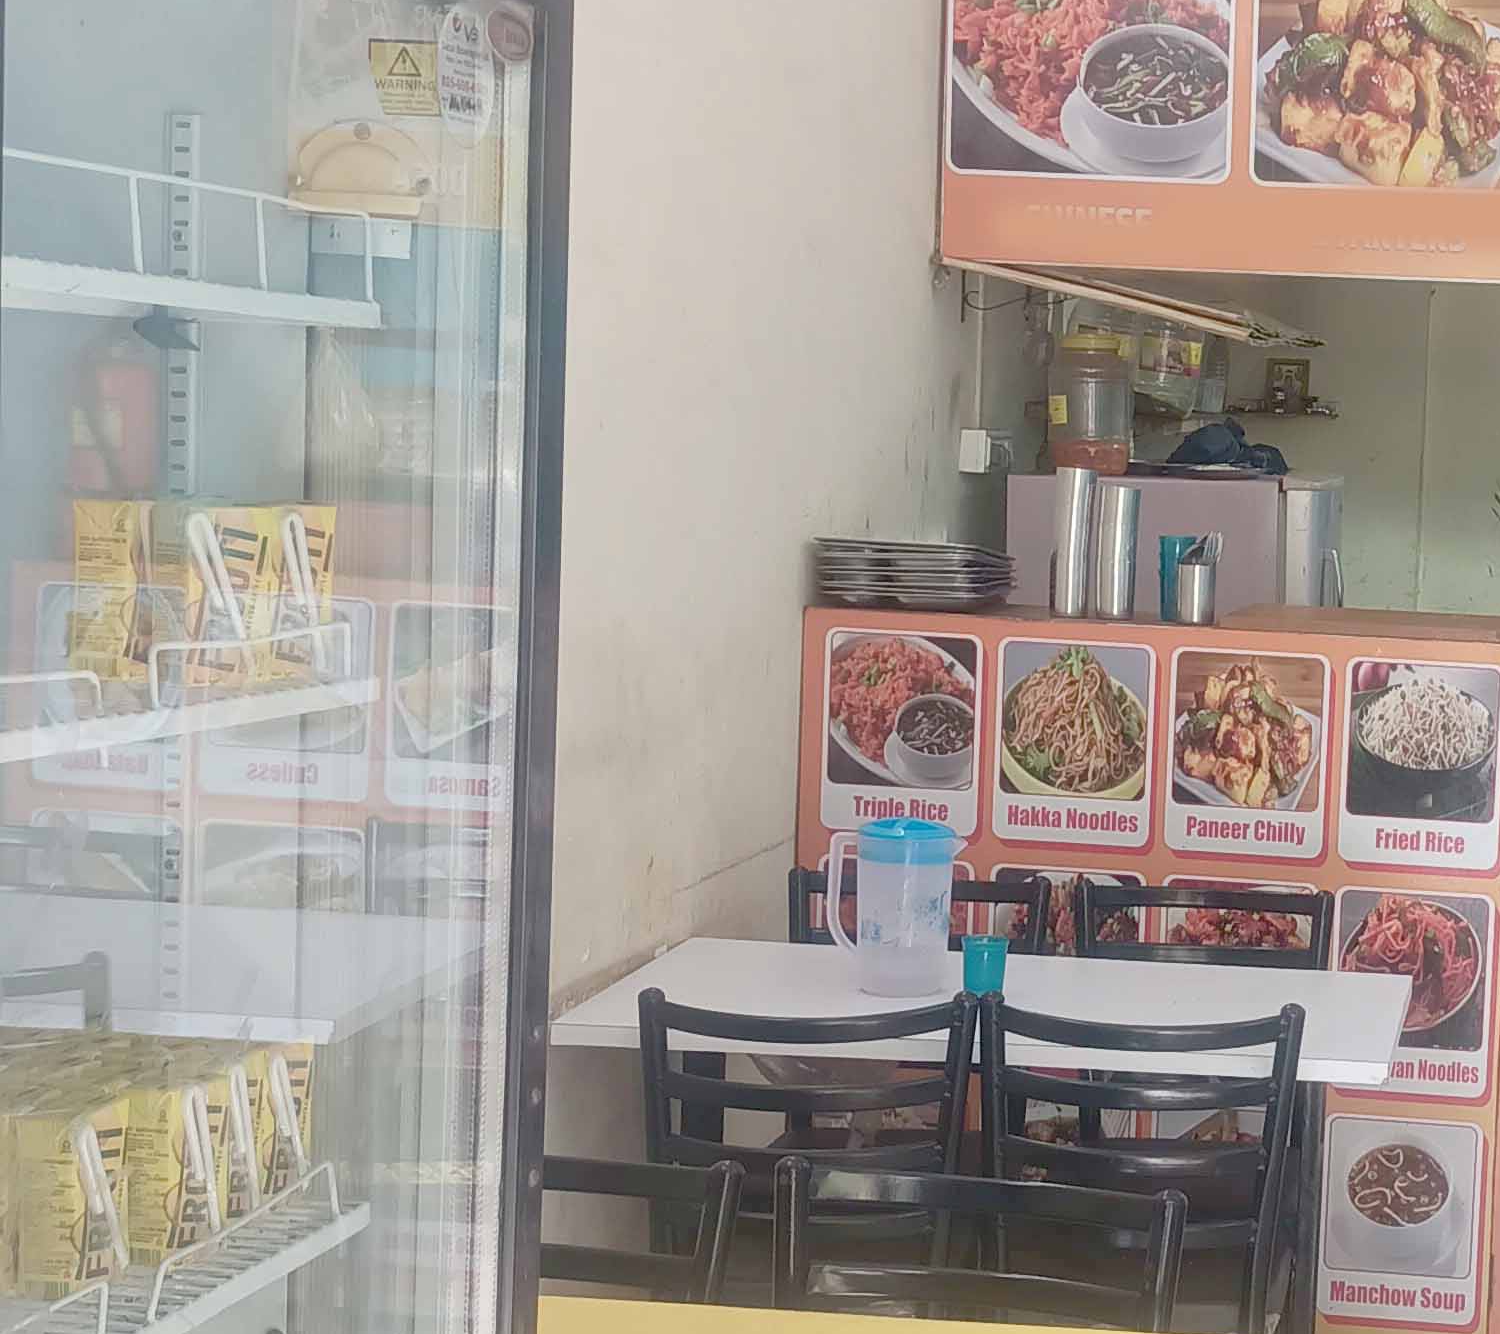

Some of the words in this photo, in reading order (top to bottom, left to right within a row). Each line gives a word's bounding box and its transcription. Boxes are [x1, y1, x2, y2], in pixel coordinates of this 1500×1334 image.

[853, 795, 905, 820] Triple
[909, 798, 949, 821] Rice
[1007, 804, 1062, 828] Hakka
[1066, 808, 1139, 833] Noodles
[1186, 815, 1250, 840] Paneer
[1253, 819, 1306, 846] Chilly
[1375, 827, 1420, 851] Fried
[1425, 832, 1465, 854] Rice
[1418, 1058, 1480, 1084] Noodles
[1329, 1280, 1417, 1307] Manchow
[1420, 1286, 1467, 1313] Soup
